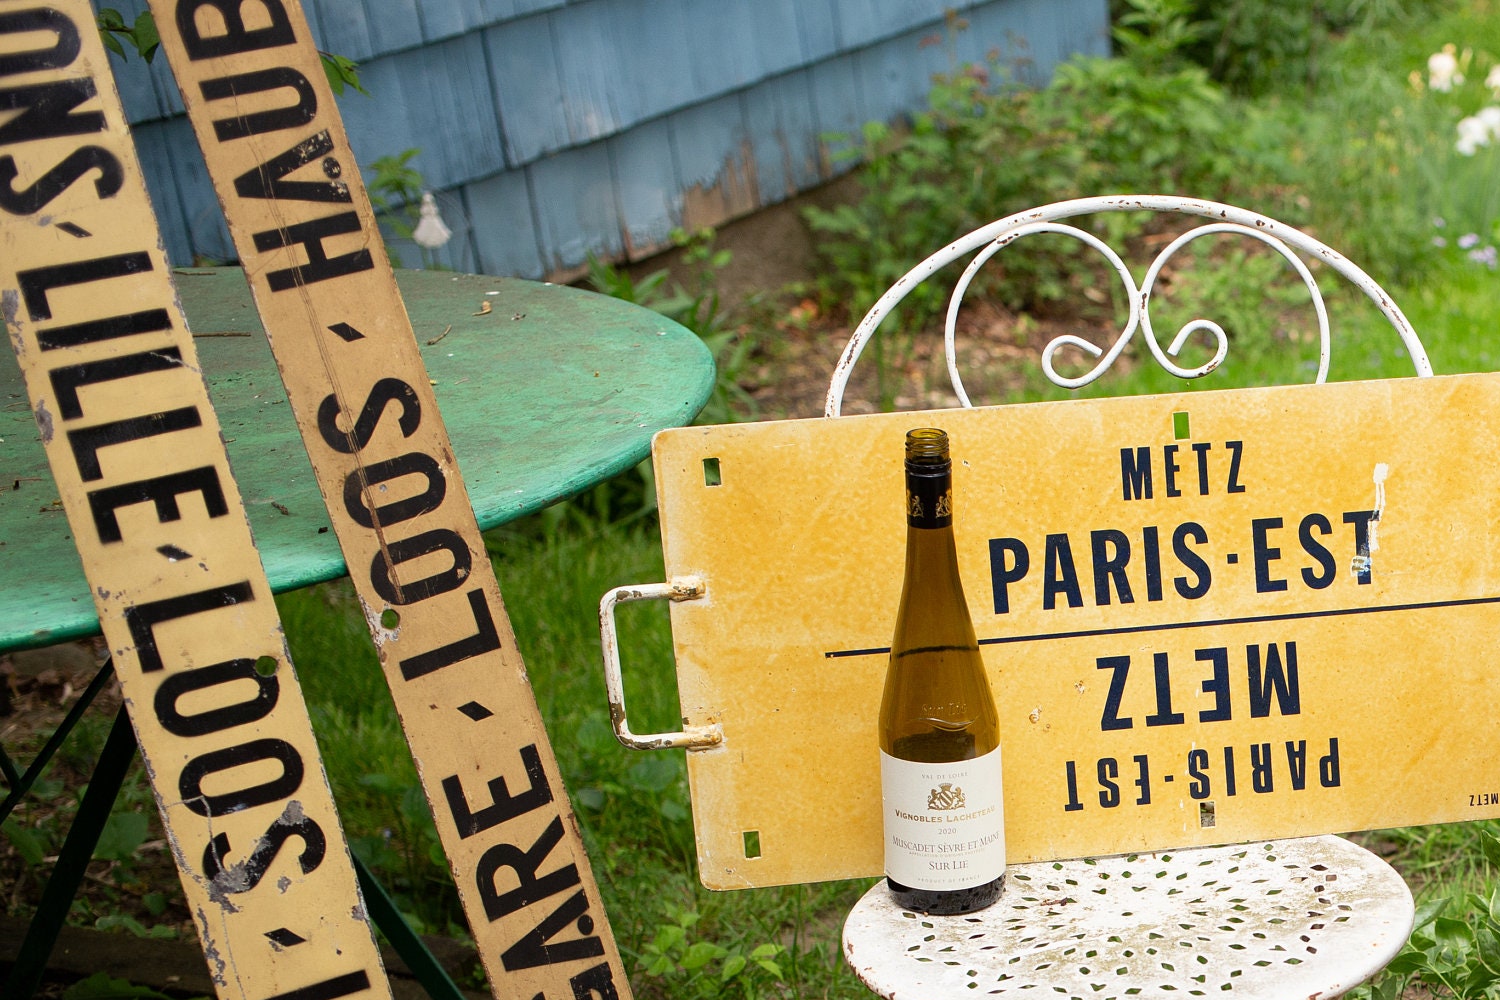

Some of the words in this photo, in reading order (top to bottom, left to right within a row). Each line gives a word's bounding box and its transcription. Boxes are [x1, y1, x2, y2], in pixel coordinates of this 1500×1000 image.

[1120, 439, 1246, 501] METZ
[317, 377, 502, 682] LOOS
[16, 251, 228, 544] LILLE
[124, 580, 327, 895] LOOS
[1095, 640, 1301, 732] METZ
[1469, 792, 1499, 806] METZ
[894, 808, 943, 823] VIGNOBLES
[946, 804, 996, 823] LACHETEAU
[938, 827, 957, 835] 2020
[892, 834, 936, 854] MUSCADET
[967, 840, 978, 851] ET
[928, 860, 951, 871] SUR
[953, 860, 969, 870] LIE
